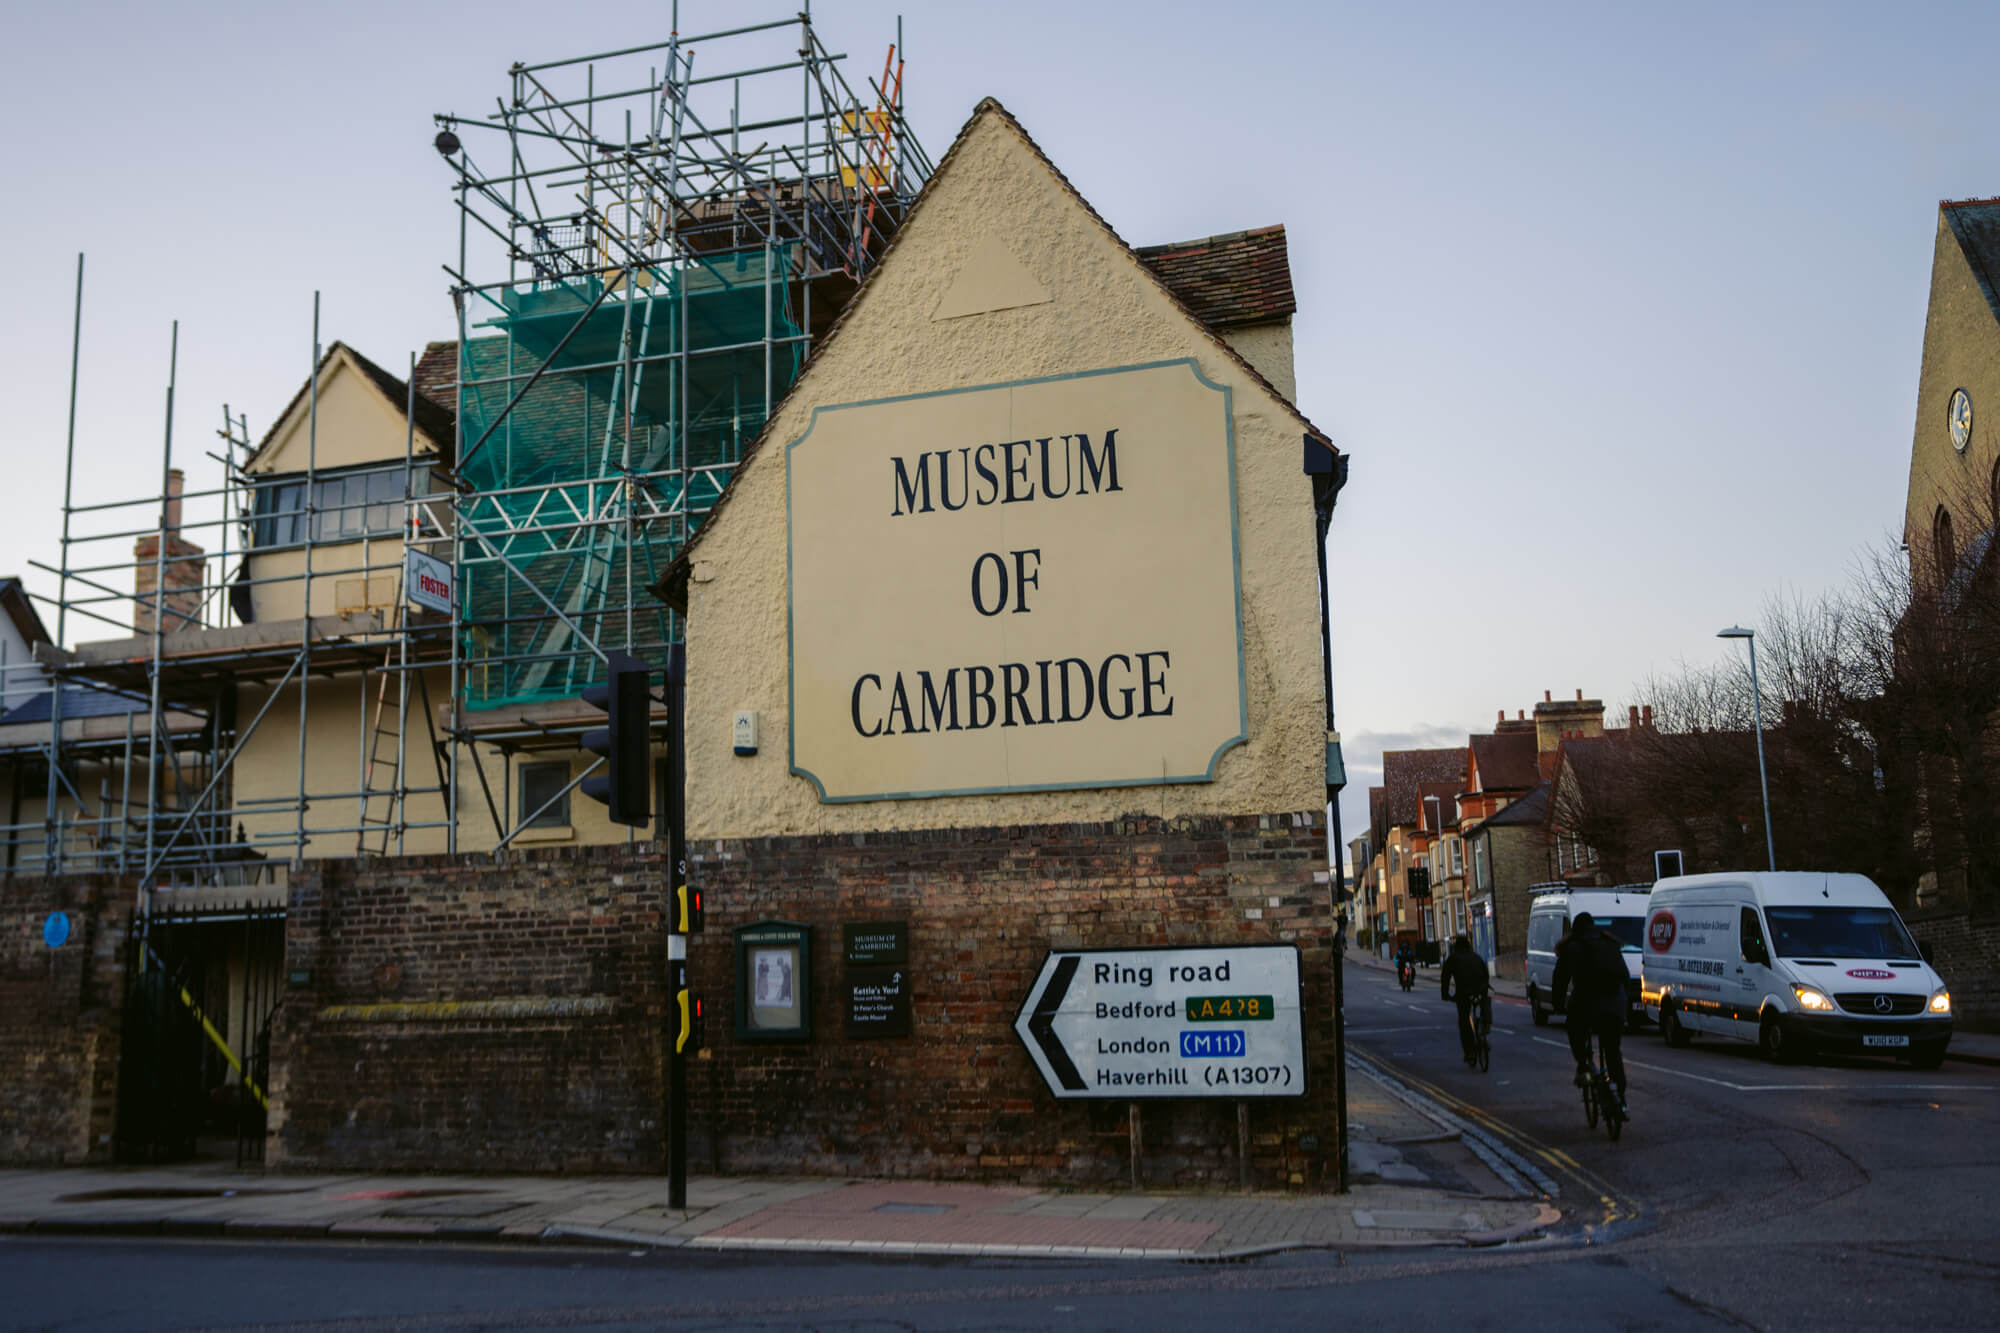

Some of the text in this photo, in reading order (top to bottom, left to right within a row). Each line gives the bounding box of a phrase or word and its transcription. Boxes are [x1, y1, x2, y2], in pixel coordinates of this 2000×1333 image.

[890, 428, 1123, 516] MUSEUM
[420, 574, 449, 600] FOSTER
[971, 548, 1041, 616] OF
[851, 651, 1174, 737] CAMBRIDGE
[1094, 960, 1231, 986] Ring road
[854, 985, 899, 995] Kettle's Yard
[1096, 1001, 1176, 1018] Bedford
[1098, 1033, 1242, 1055] London (M11)
[1097, 1064, 1291, 1086] Haverhill (A1307)
